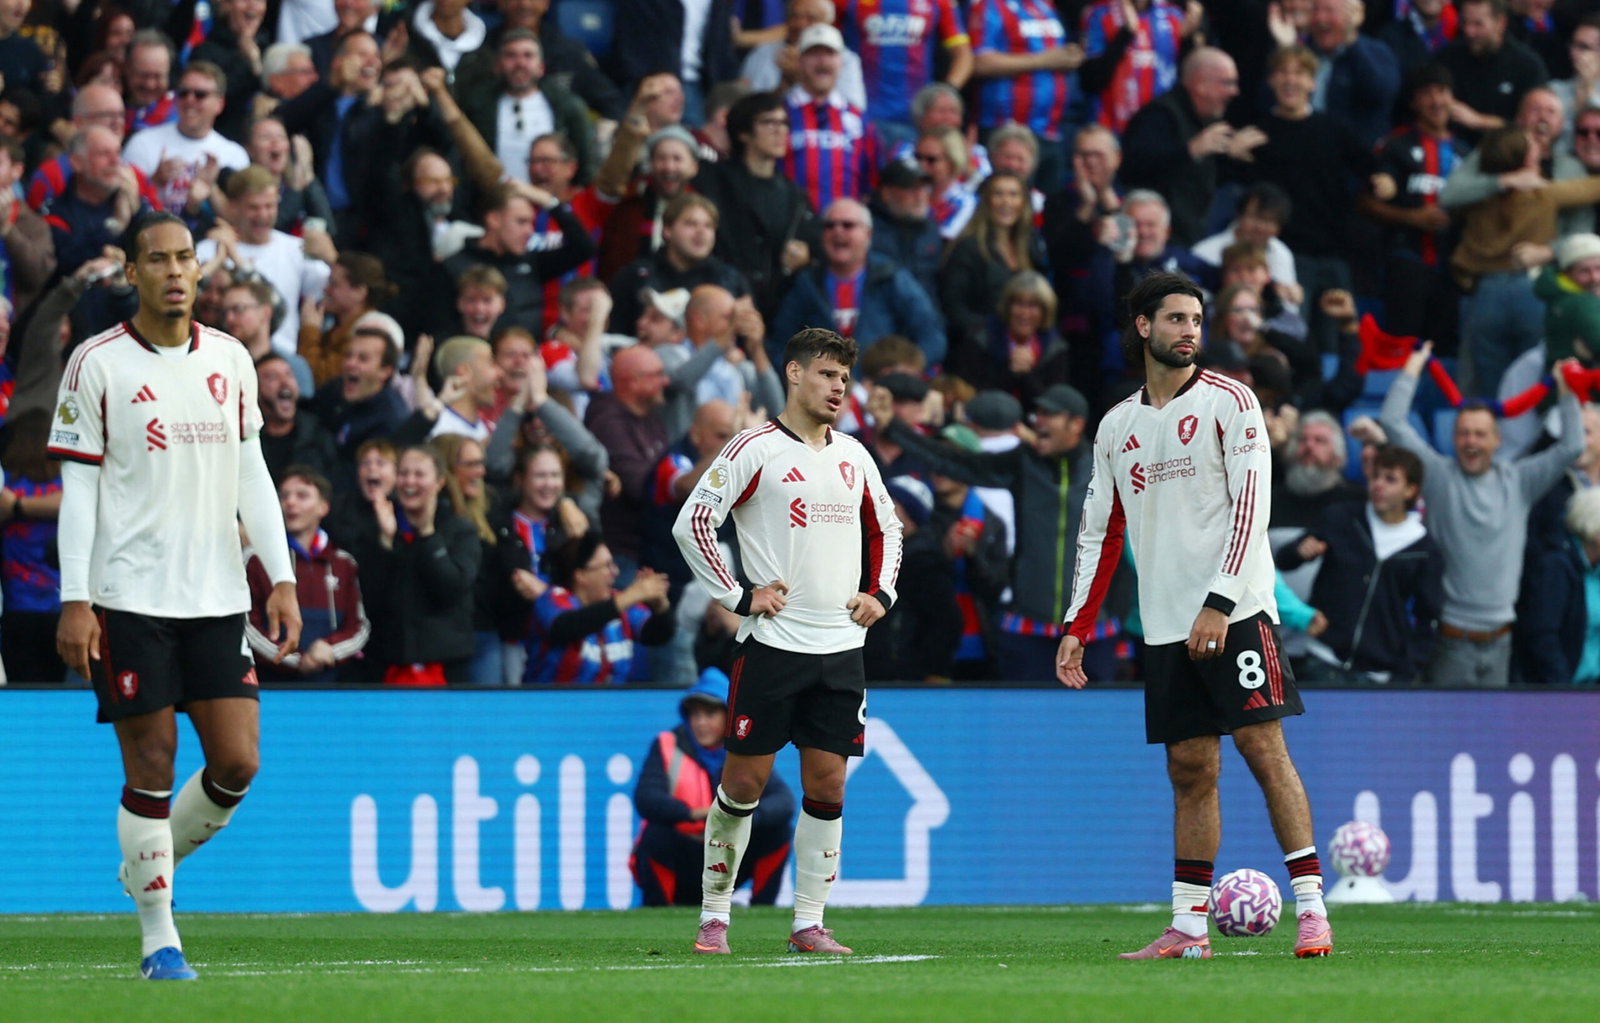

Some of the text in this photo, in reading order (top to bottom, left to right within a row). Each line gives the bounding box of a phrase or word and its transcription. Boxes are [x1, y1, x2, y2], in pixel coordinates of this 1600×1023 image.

[170, 420, 224, 433] standard
[810, 502, 854, 513] standard
[810, 512, 854, 525] chartered
[1236, 649, 1266, 690] 8
[351, 753, 634, 913] utili
[1354, 752, 1600, 903] util
[709, 839, 735, 851] LFC
